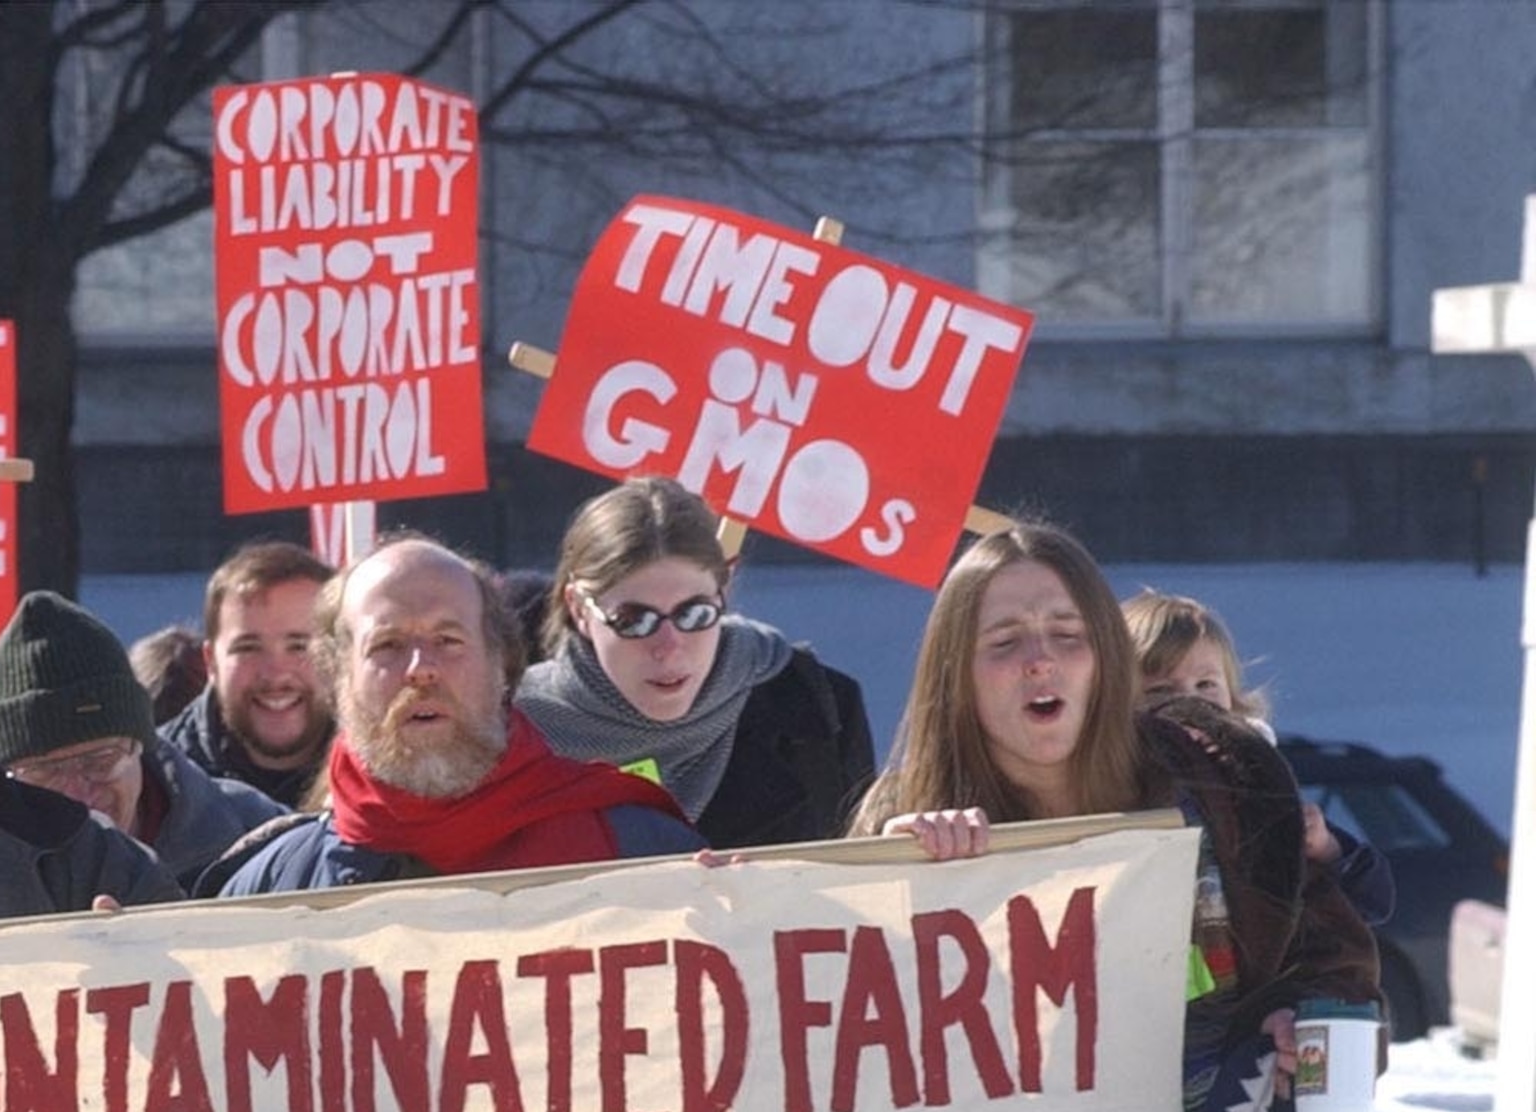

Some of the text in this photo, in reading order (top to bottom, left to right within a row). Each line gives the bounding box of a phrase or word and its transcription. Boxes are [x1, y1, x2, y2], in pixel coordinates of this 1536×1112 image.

[217, 81, 474, 165] CORPORATE
[229, 153, 470, 236] LIABILITY
[259, 231, 434, 287] NOT
[222, 268, 477, 388] CORPORATE
[613, 204, 1023, 418] TIME OUT
[241, 376, 446, 495] CONTROL
[708, 346, 819, 428] ON
[582, 361, 917, 558] GMOs
